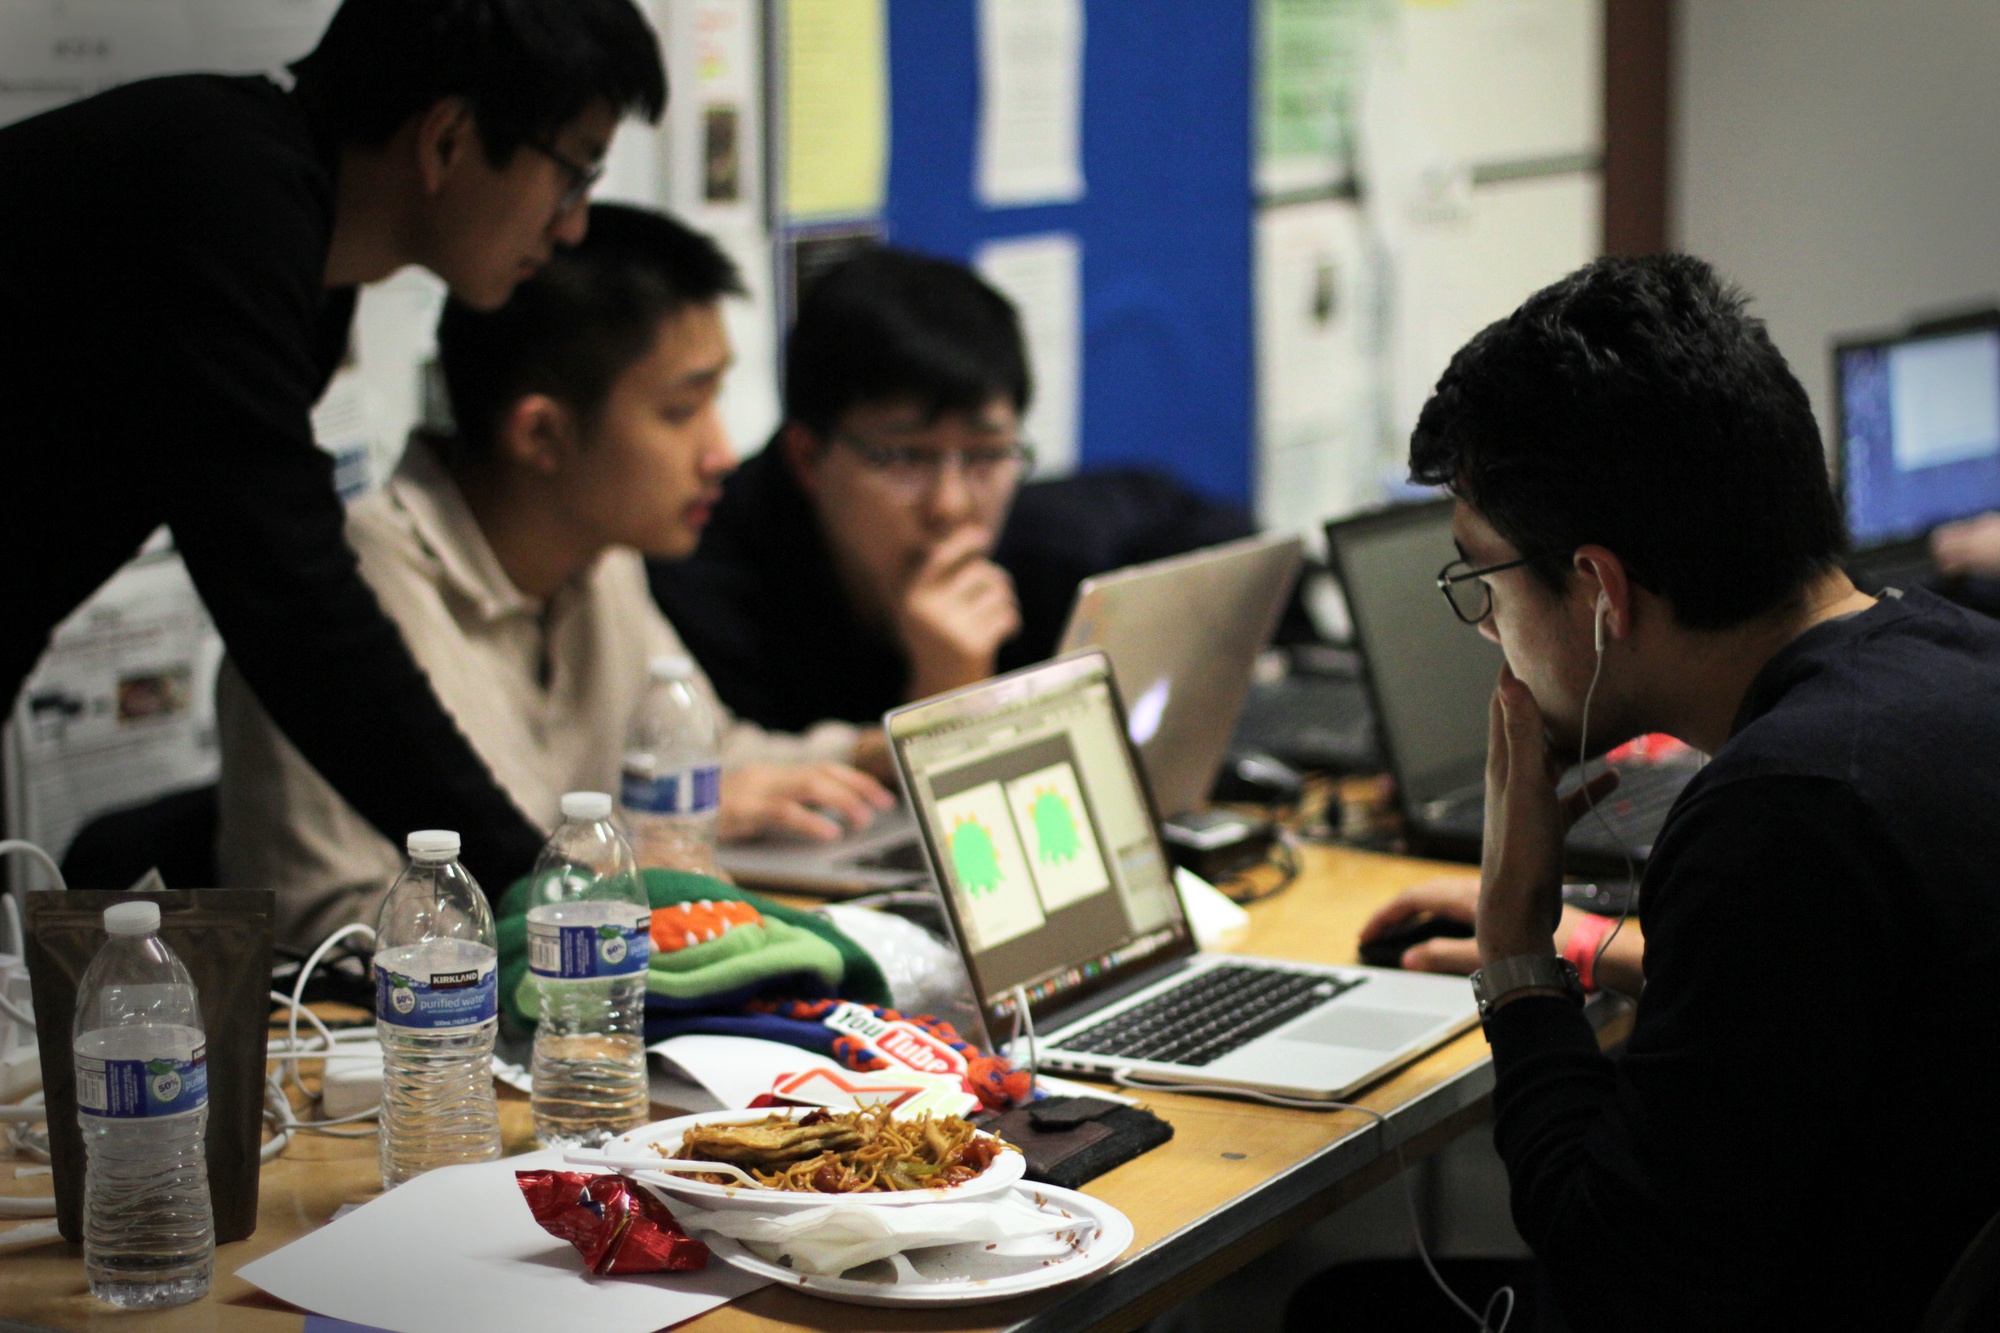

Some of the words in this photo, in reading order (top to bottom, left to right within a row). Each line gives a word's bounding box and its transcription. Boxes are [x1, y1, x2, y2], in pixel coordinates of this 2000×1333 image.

[432, 971, 478, 984] KIRKLAND
[396, 994, 413, 1004] 50%
[420, 997, 460, 1011] purified
[462, 994, 485, 1006] water
[158, 1077, 179, 1093] 50%
